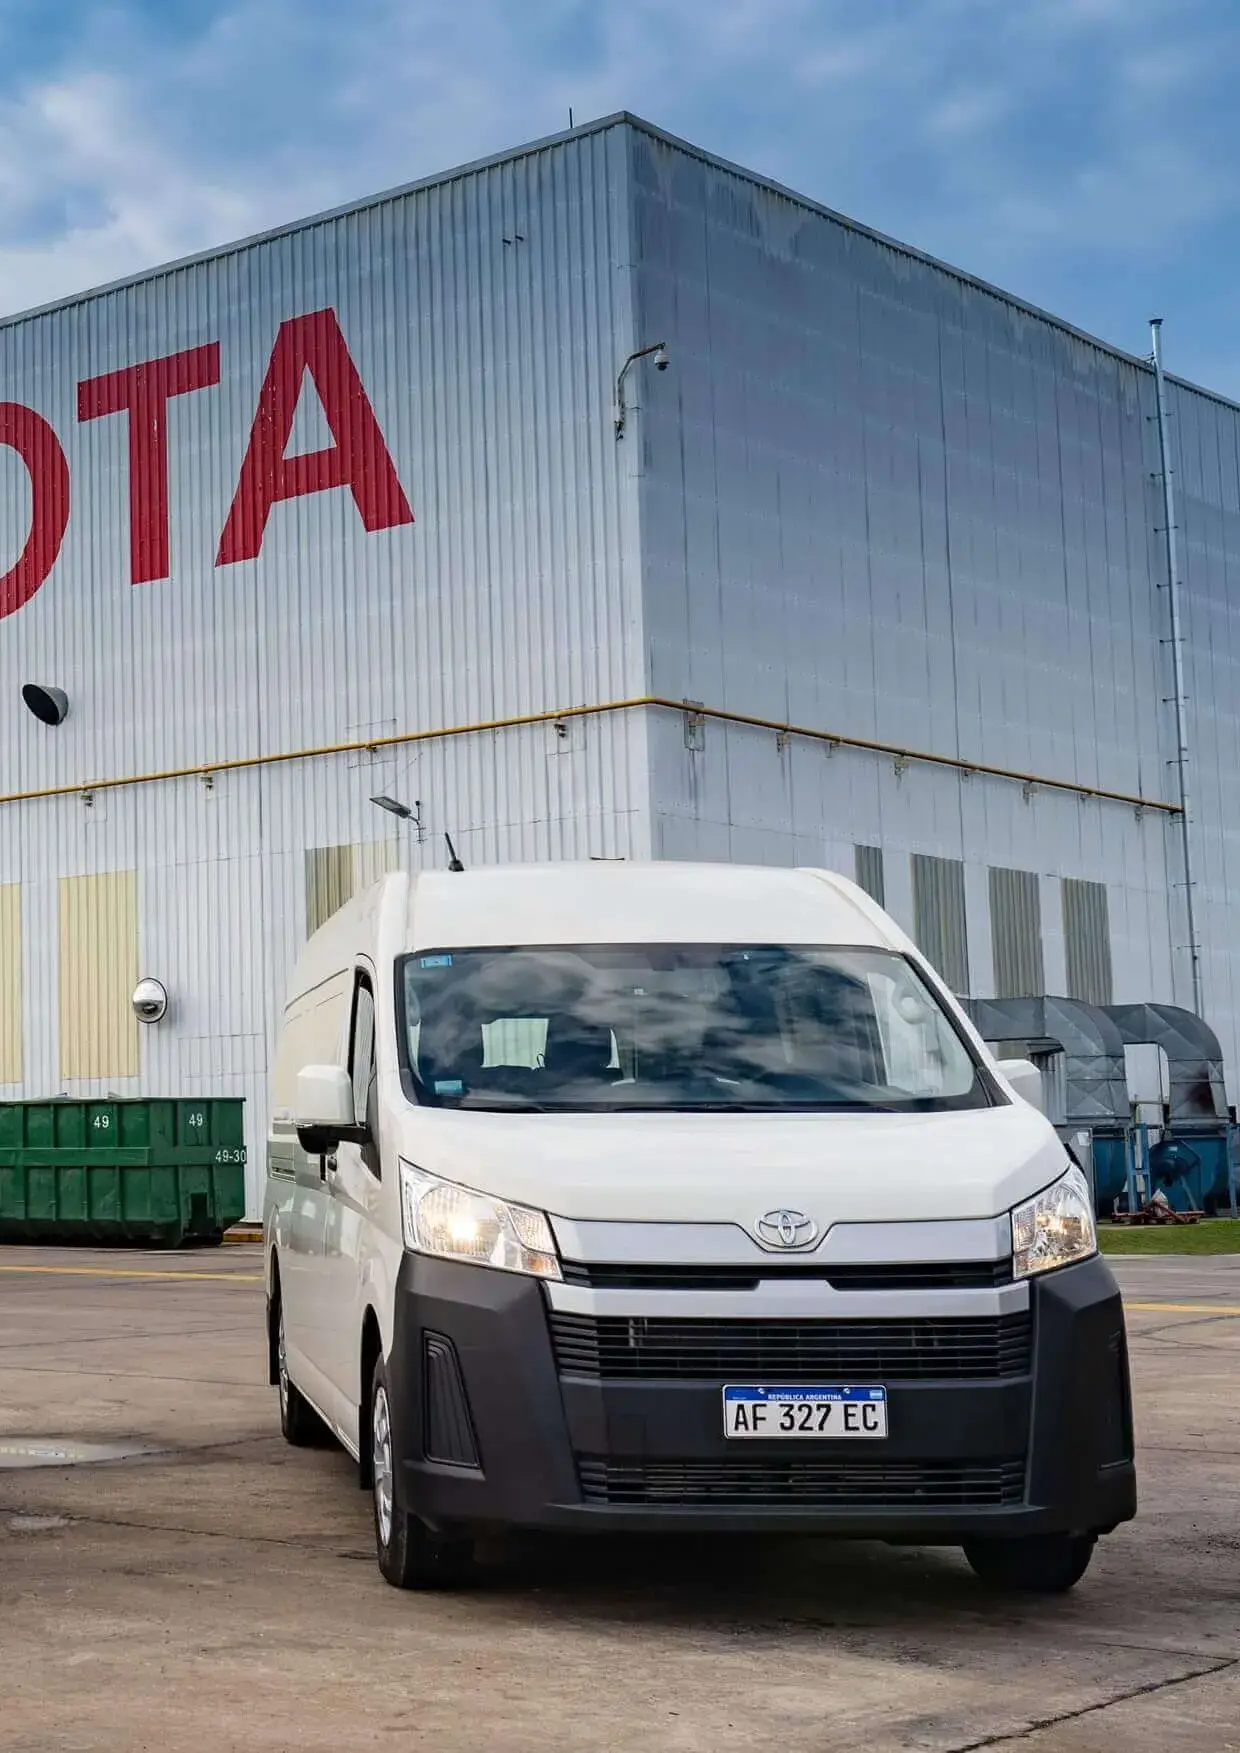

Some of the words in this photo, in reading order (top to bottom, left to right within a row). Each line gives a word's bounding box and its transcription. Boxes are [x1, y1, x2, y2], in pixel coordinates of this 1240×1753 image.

[93, 1115, 110, 1129] 49
[188, 1113, 204, 1128] 49
[215, 1149, 247, 1163] 49-30
[805, 1393, 842, 1401] ARGENTINA
[733, 1403, 767, 1431] AF
[779, 1403, 832, 1431] 327
[843, 1403, 879, 1431] EC
